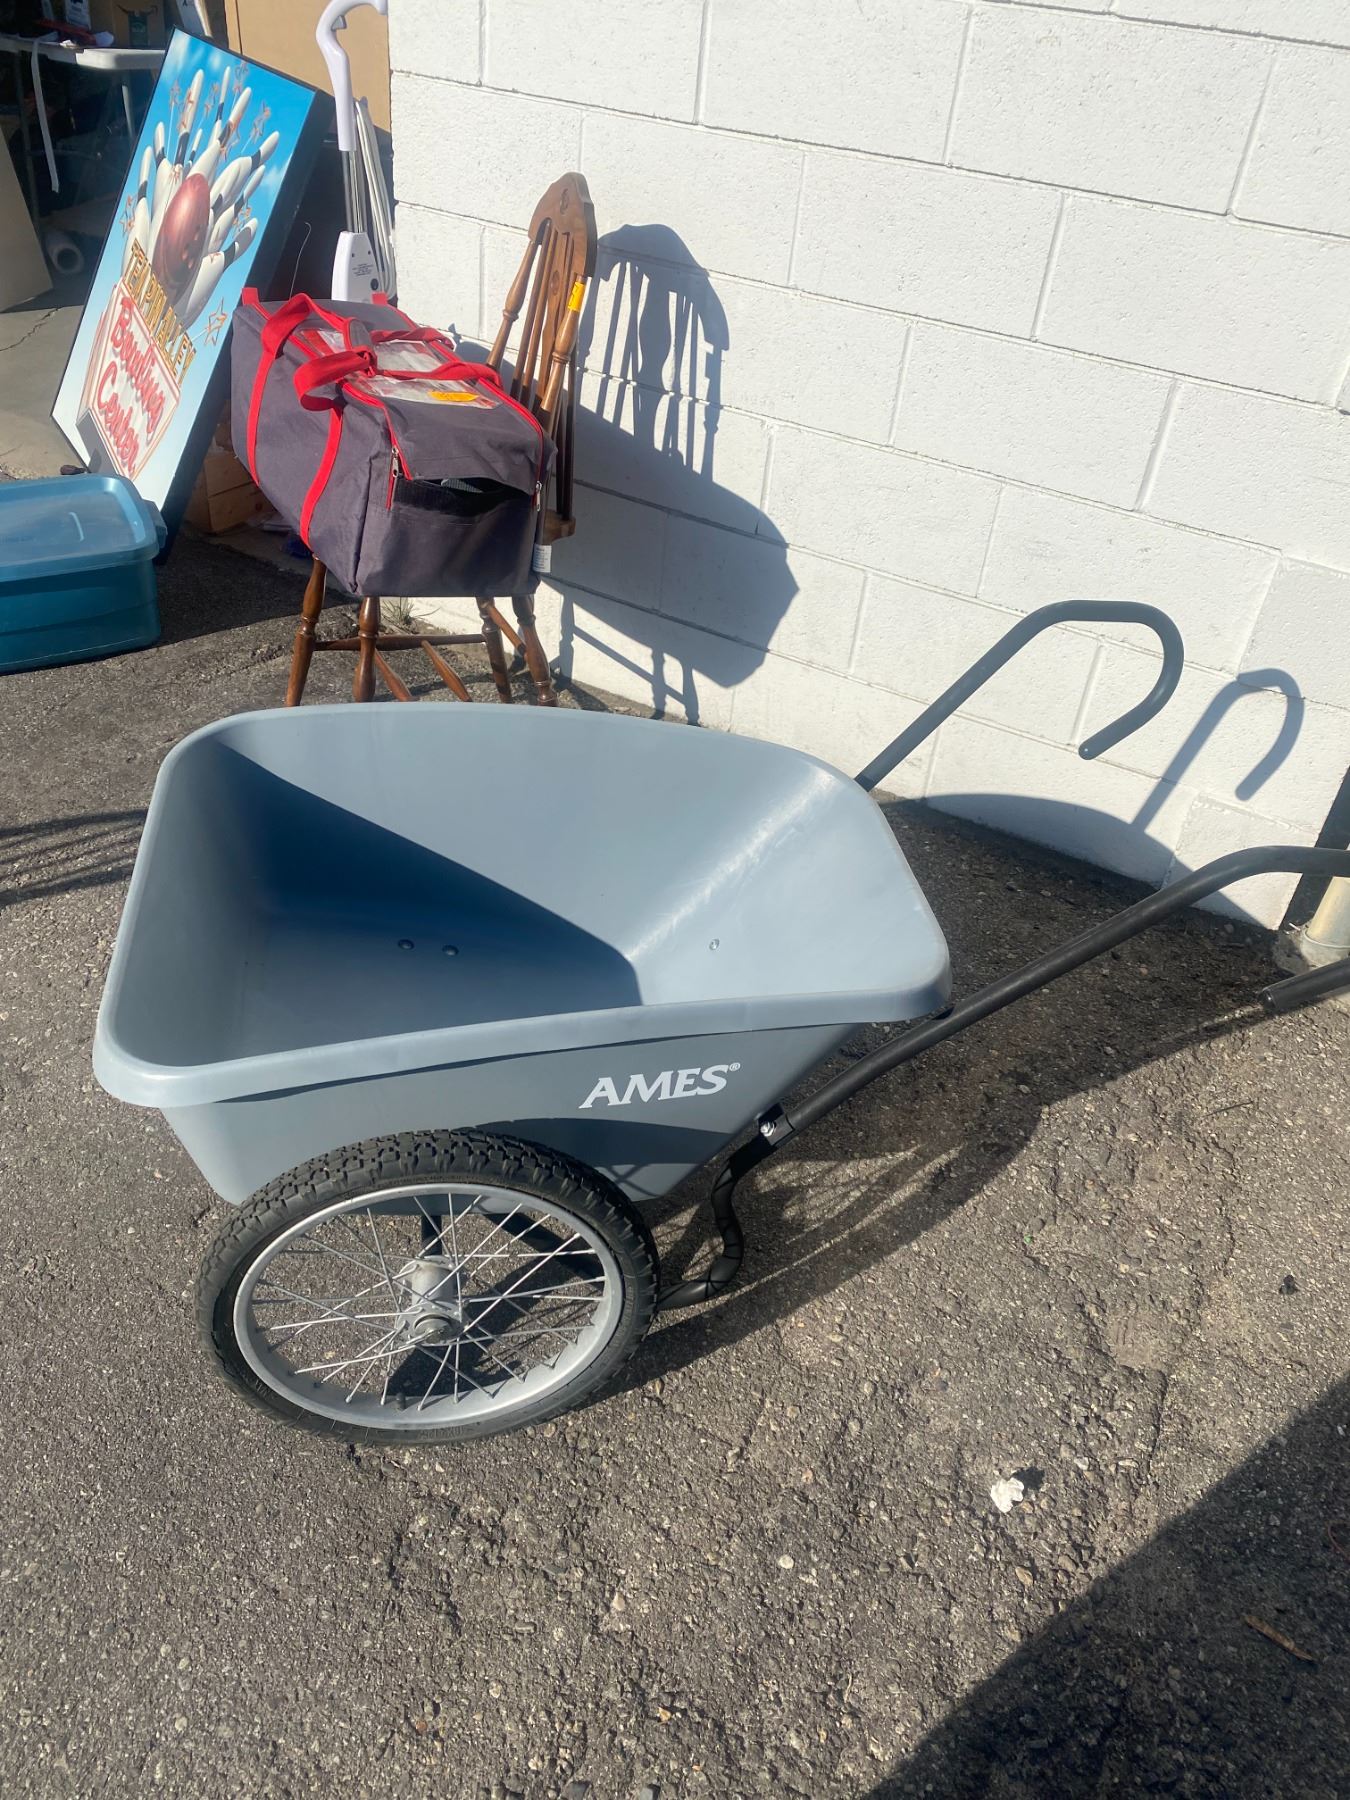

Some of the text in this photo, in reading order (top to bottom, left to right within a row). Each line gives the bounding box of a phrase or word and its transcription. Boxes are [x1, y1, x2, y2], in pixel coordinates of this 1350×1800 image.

[111, 297, 165, 437] Bowling
[123, 238, 196, 386] TEN PIN ALLEY
[97, 361, 139, 471] Center
